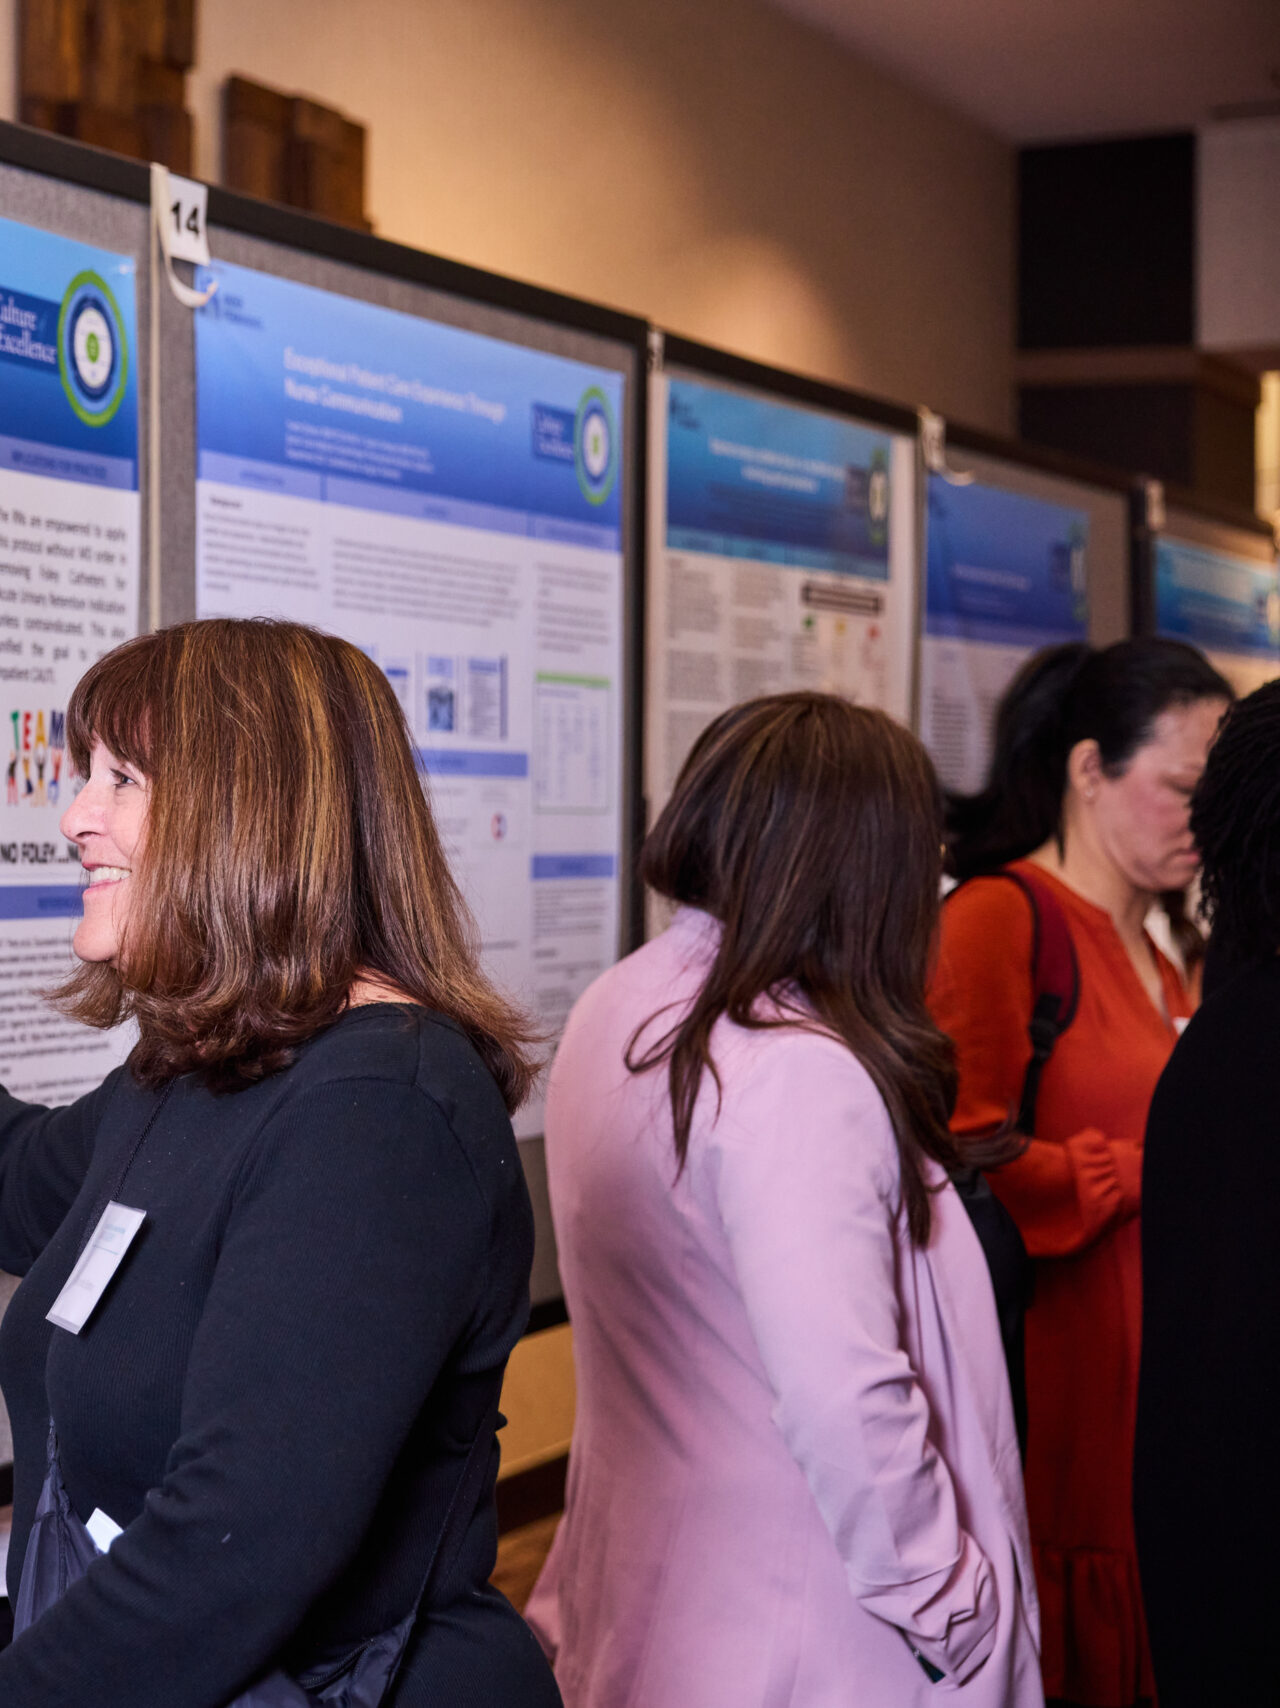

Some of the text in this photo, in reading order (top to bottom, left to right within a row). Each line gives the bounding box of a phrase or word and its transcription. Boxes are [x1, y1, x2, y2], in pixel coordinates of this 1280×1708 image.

[171, 201, 200, 236] 14
[10, 709, 65, 751] TEAM
[0, 842, 18, 864] NO
